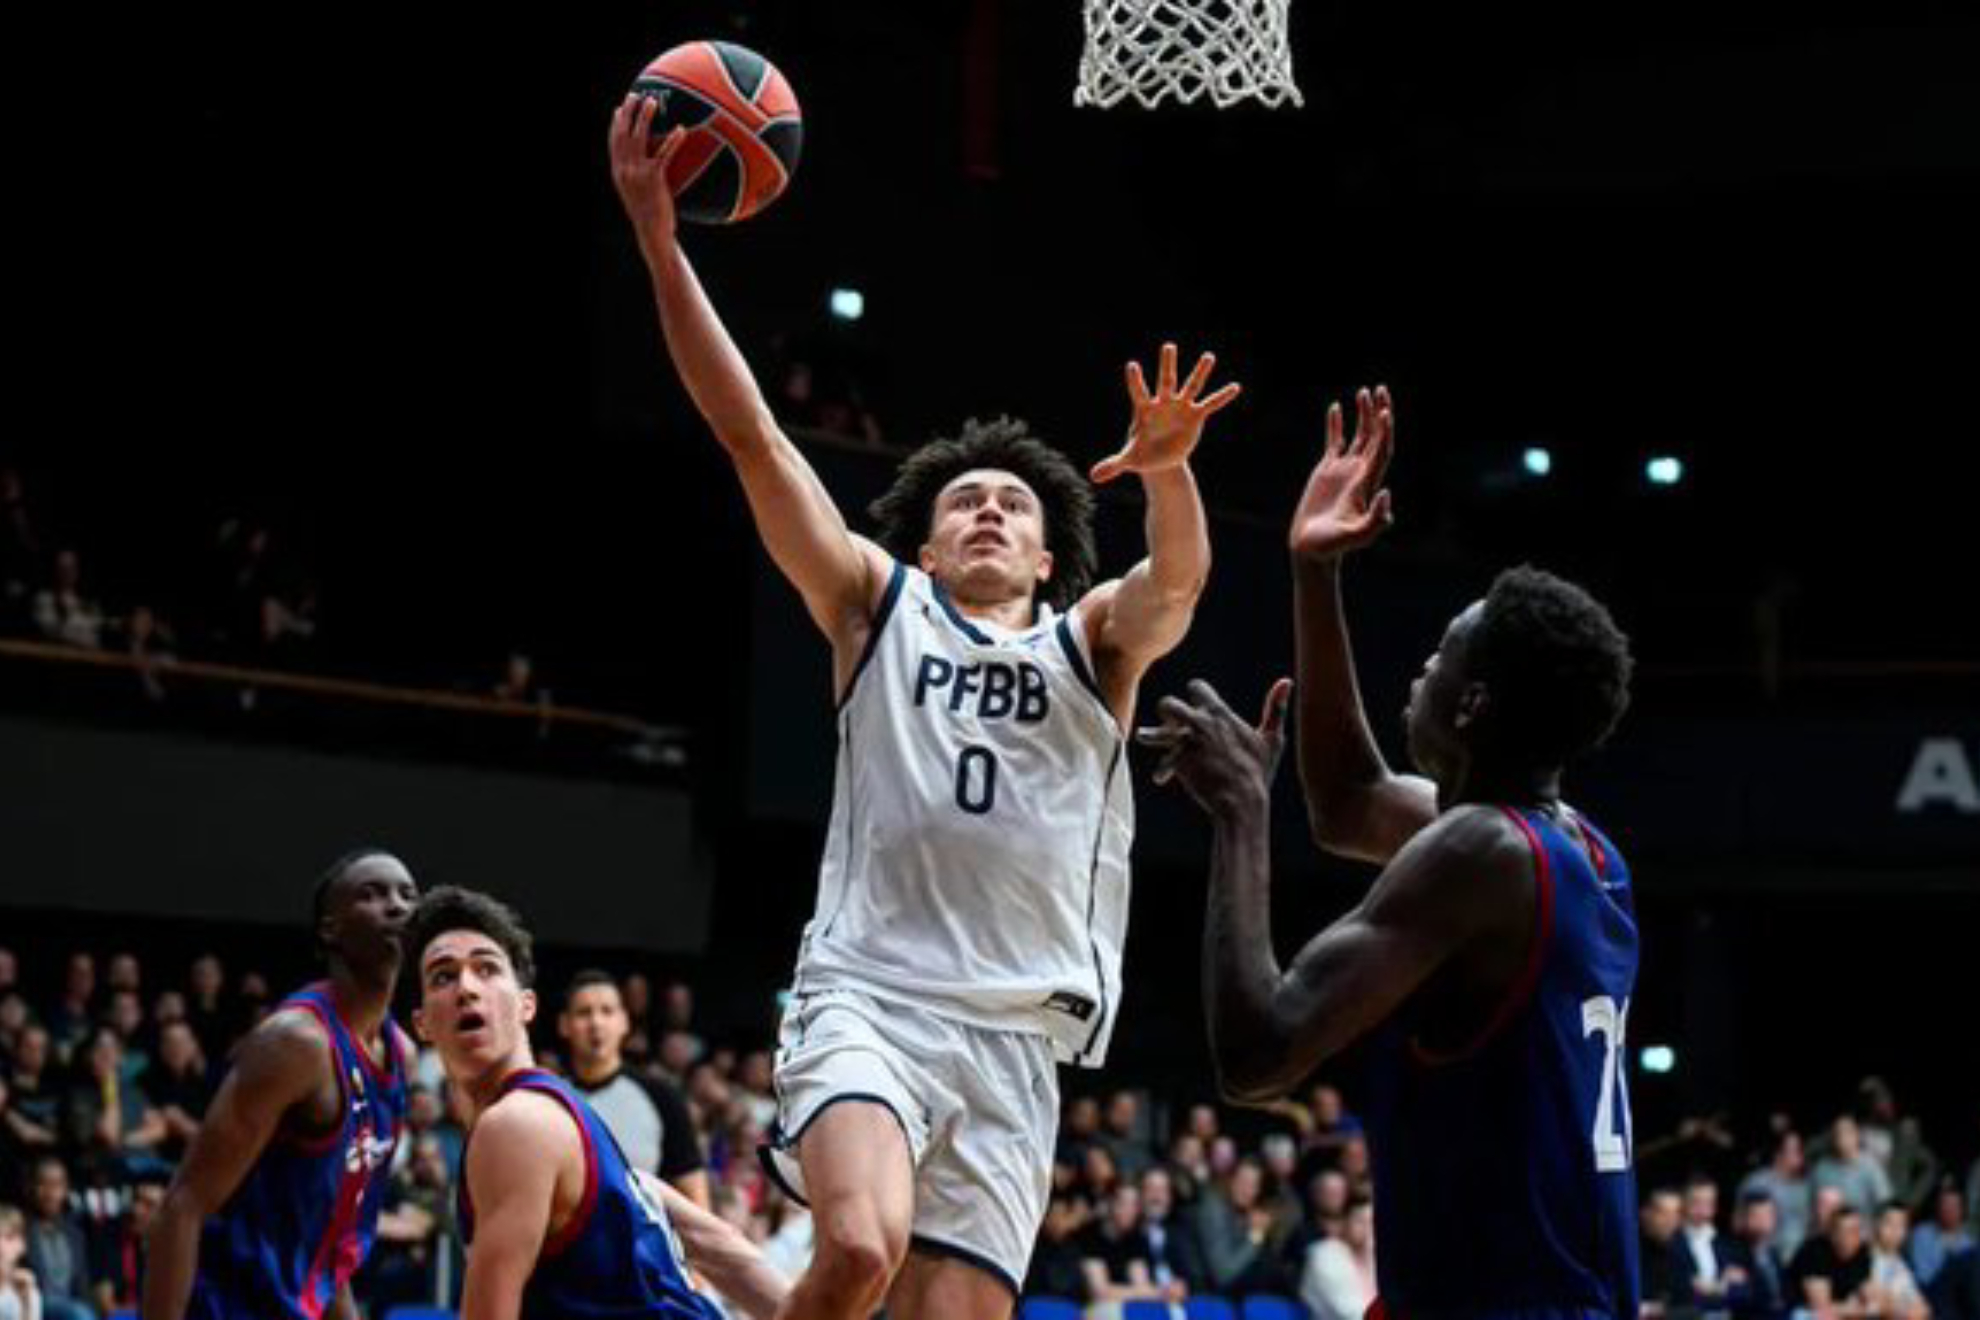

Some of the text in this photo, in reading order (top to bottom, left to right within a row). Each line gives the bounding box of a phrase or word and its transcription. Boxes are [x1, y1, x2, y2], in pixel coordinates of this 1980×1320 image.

[914, 654, 1050, 722] PFBB
[955, 744, 997, 814] 0
[1895, 737, 1980, 813] A
